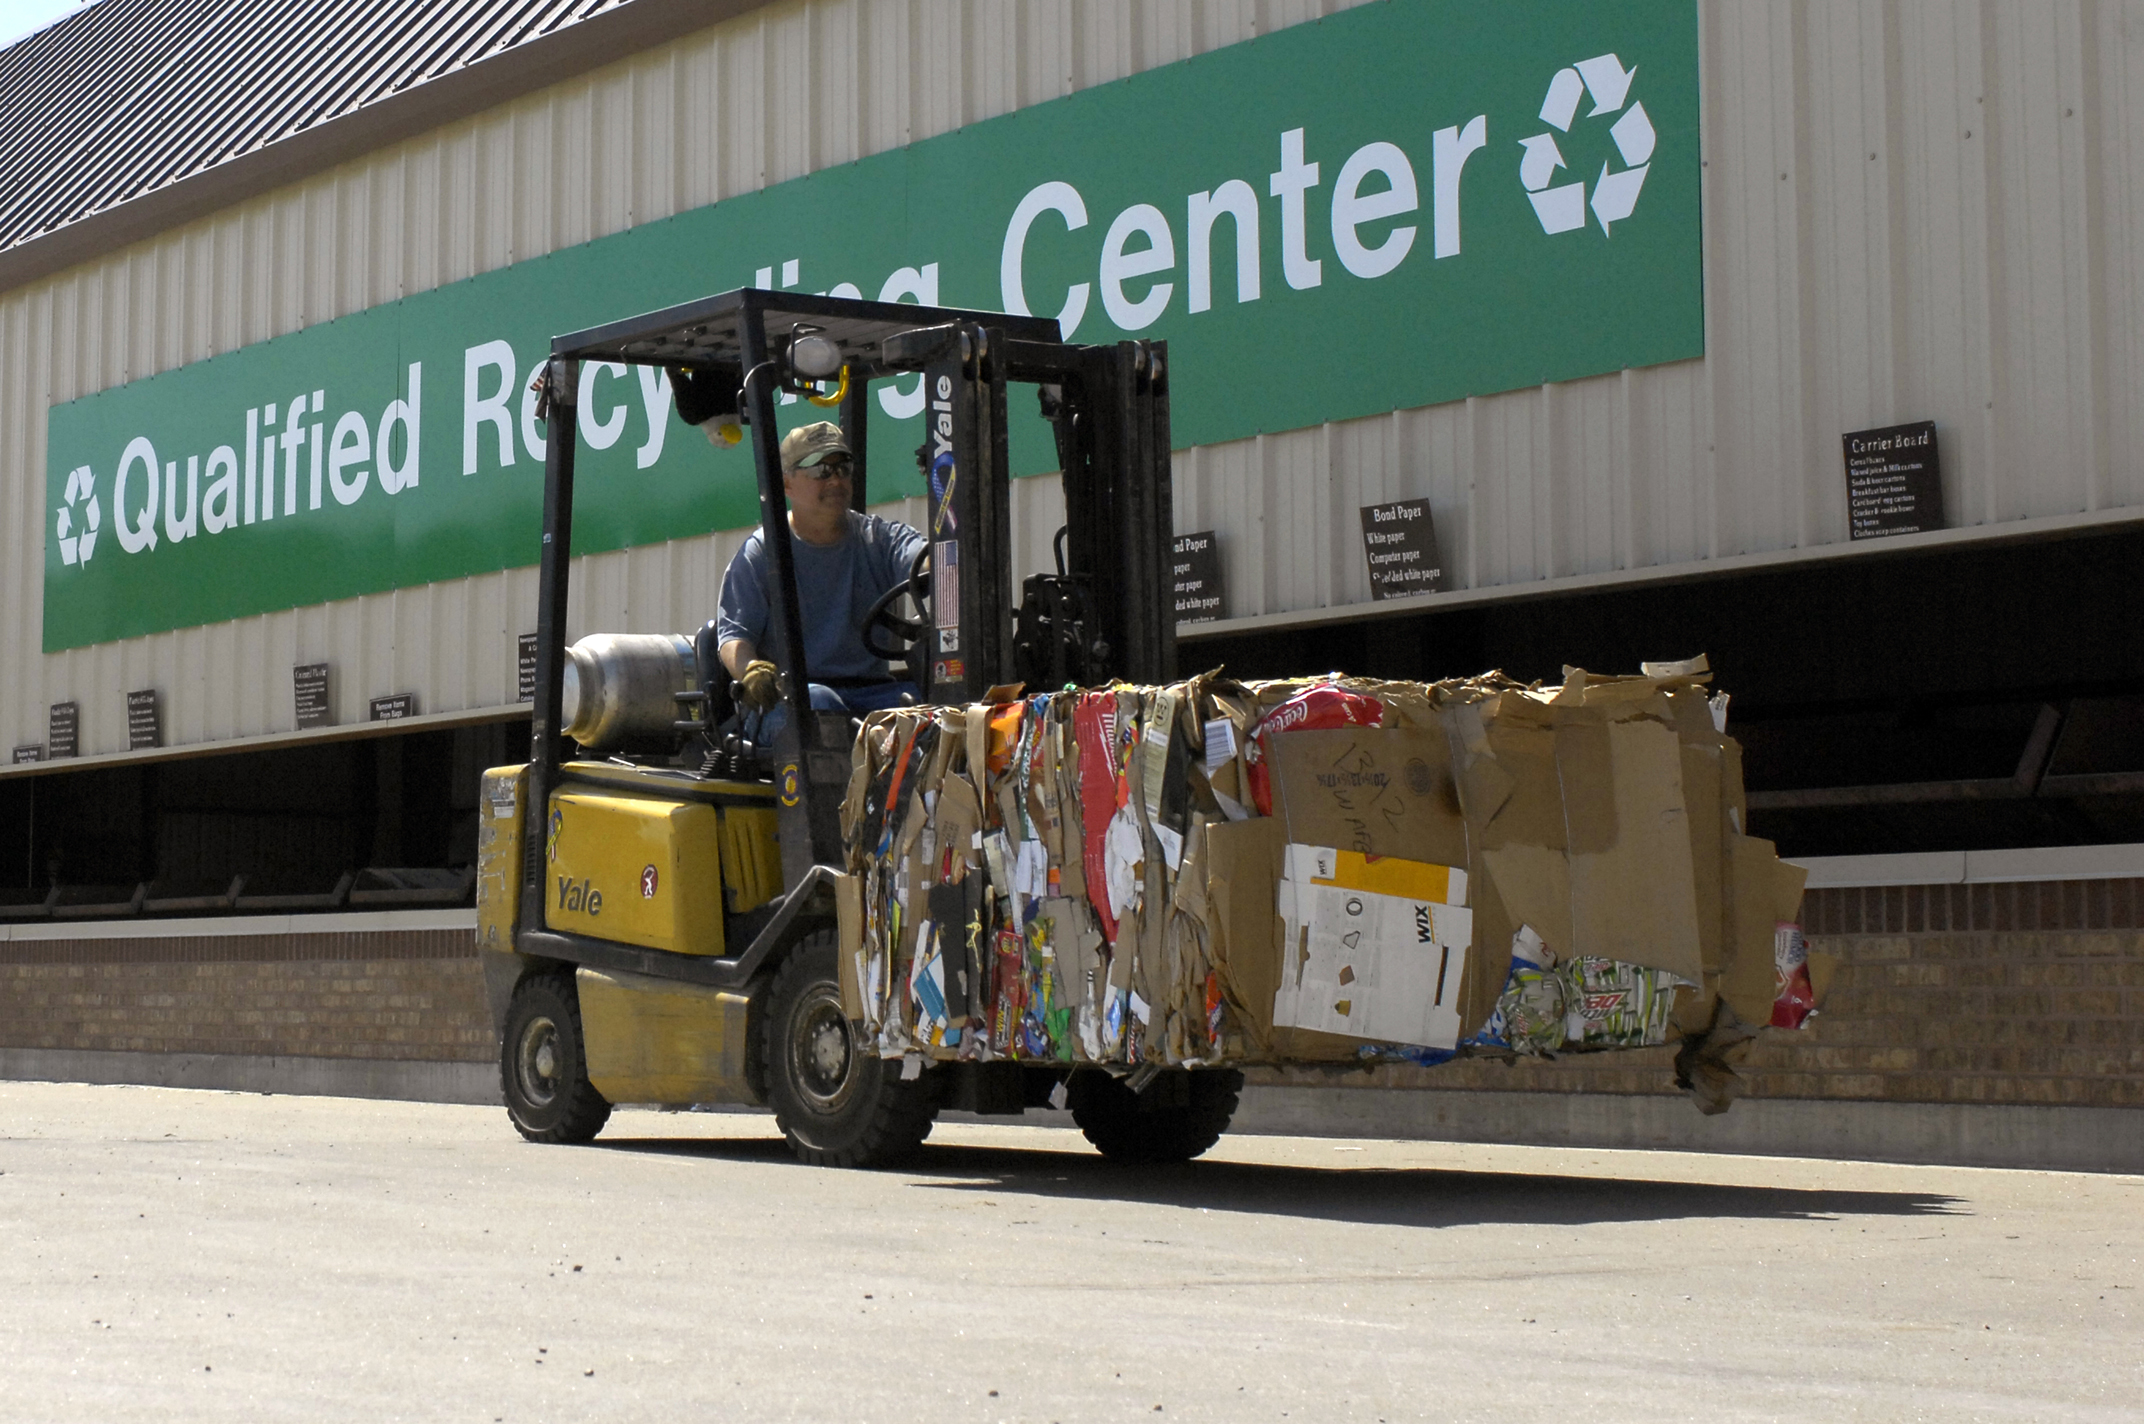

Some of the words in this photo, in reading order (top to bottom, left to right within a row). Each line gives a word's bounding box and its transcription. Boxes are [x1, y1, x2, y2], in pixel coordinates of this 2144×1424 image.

[113, 361, 422, 554] Qualified
[1000, 114, 1487, 343] Center
[933, 375, 952, 459] Yale
[1852, 437, 1892, 453] Carrier
[1895, 431, 1928, 448] Board
[1374, 507, 1396, 522] Bond
[1397, 505, 1421, 521] Paper
[1173, 539, 1184, 553] nd
[1185, 538, 1207, 553] Paper
[1366, 532, 1386, 544] White
[1387, 532, 1405, 545] paper
[1369, 551, 1401, 565] Computer
[1402, 550, 1420, 563] paper
[1174, 563, 1191, 576] paper
[1404, 568, 1421, 581] white
[1422, 568, 1440, 581] paper
[1186, 580, 1202, 593] paper
[1186, 597, 1202, 609] white
[1202, 597, 1220, 610] paper
[1318, 859, 1327, 875] WIX
[558, 876, 602, 916] Yale
[1415, 905, 1431, 943] WIX
